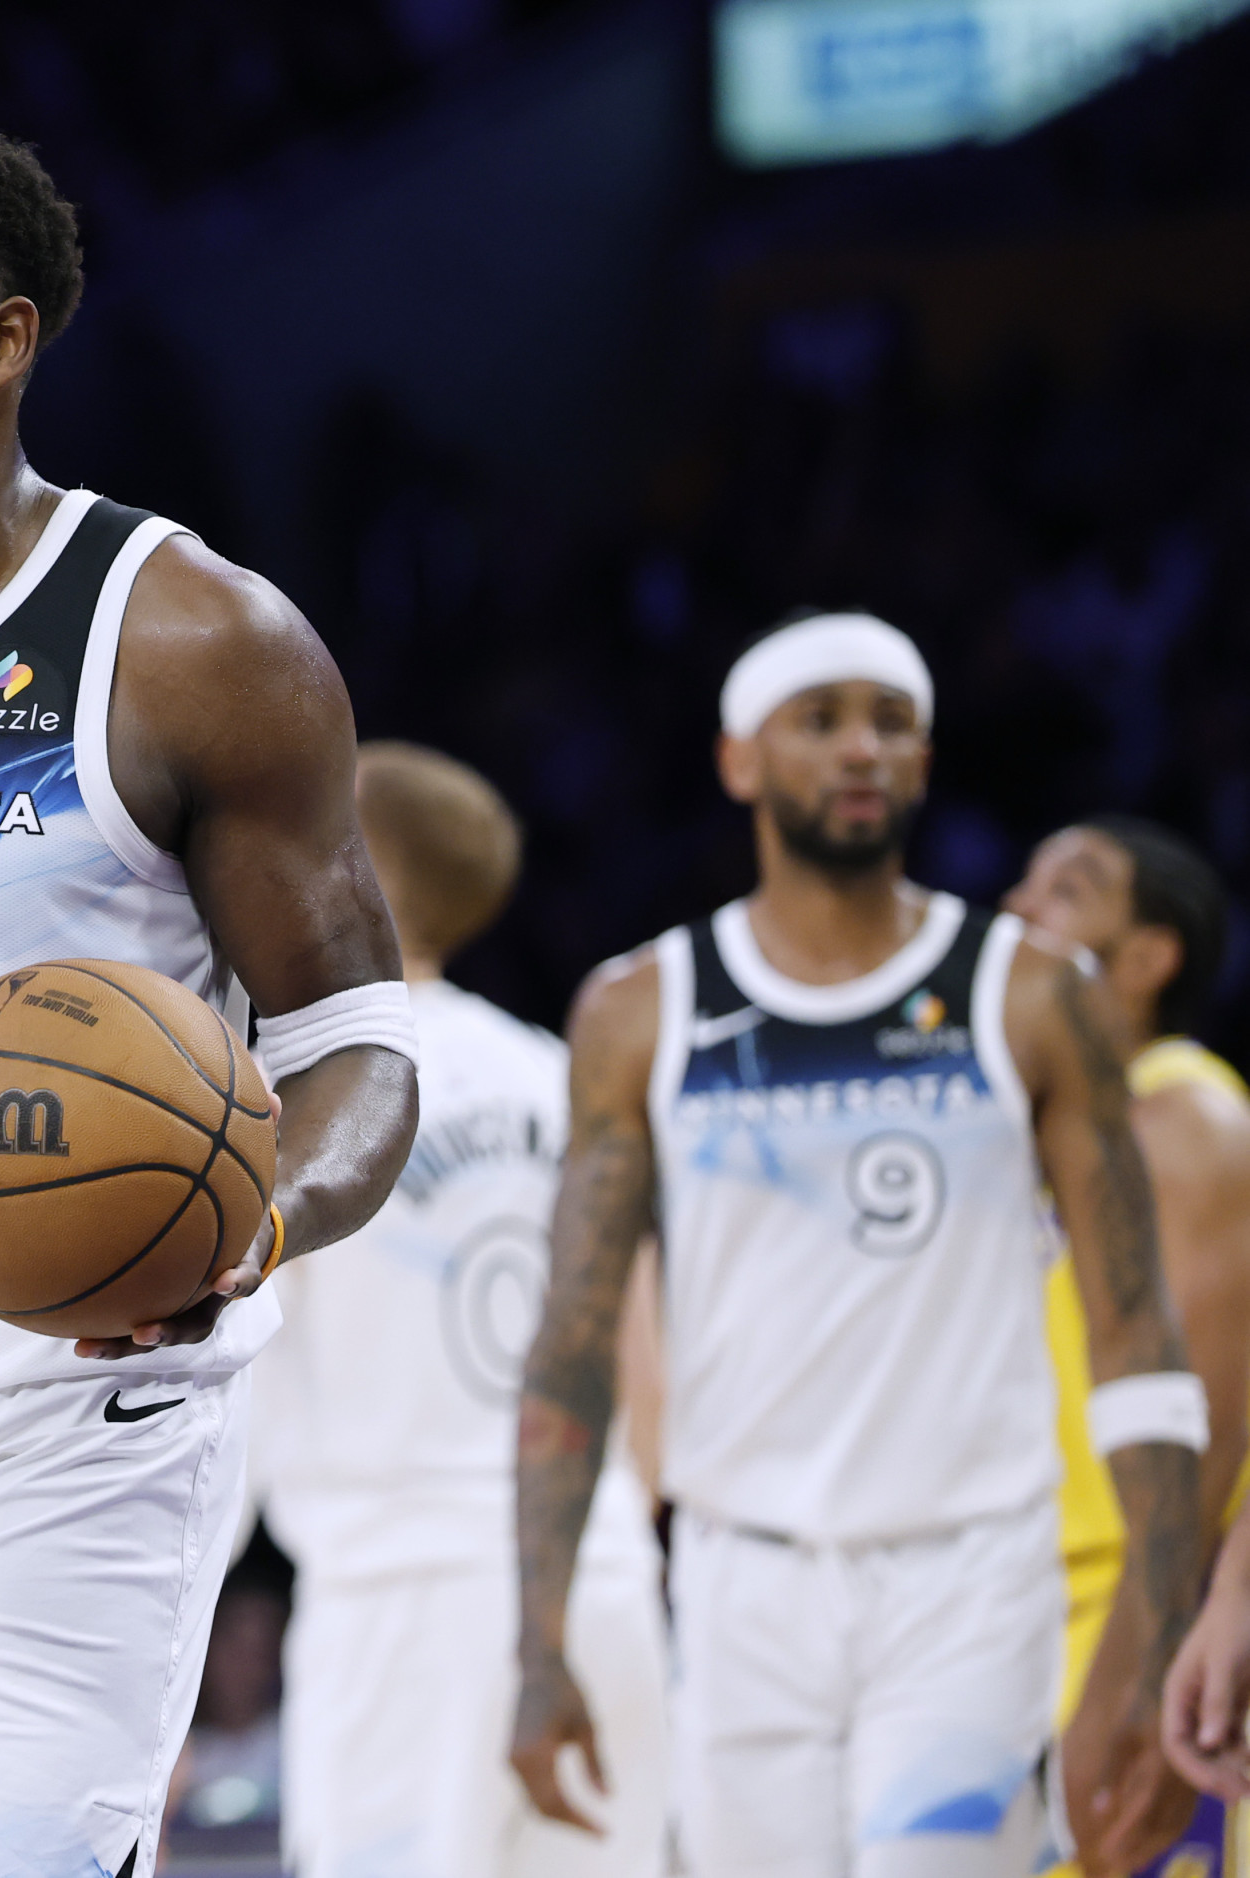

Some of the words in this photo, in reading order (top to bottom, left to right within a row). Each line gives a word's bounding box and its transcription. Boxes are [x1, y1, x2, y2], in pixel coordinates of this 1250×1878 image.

[39, 998, 66, 1012] GAME
[62, 1004, 99, 1028] OFFICIAL
[846, 1128, 947, 1260] 9
